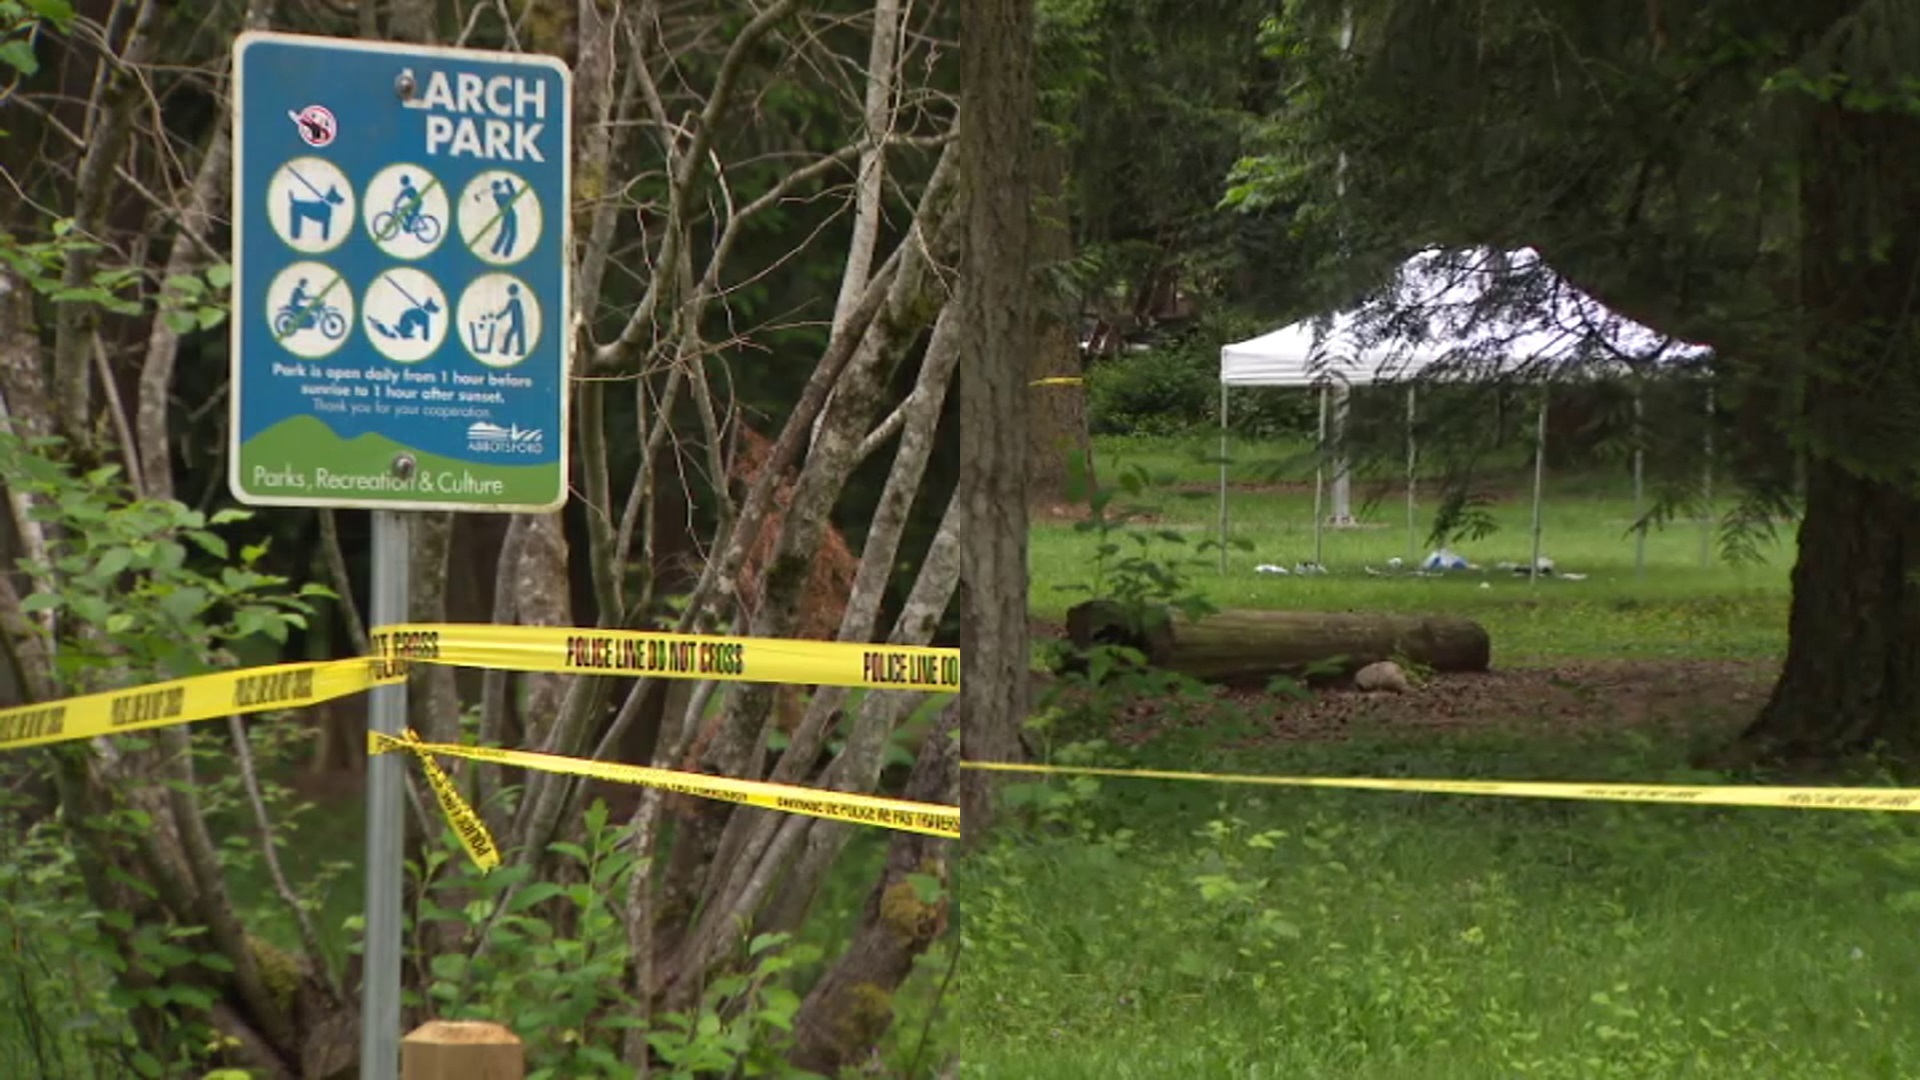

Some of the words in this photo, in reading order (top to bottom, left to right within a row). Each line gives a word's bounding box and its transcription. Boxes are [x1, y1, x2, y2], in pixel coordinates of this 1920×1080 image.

[402, 68, 546, 118] LARCH
[426, 116, 545, 162] PARK
[272, 362, 306, 377] Park
[310, 363, 323, 377] is
[325, 368, 361, 382] open
[365, 366, 399, 385] daily
[403, 367, 436, 384] from
[442, 370, 448, 384] 1
[453, 370, 485, 385] hour
[488, 371, 533, 388] before
[301, 382, 350, 396] sunrise
[354, 385, 369, 397] to
[374, 385, 380, 397] 1
[386, 385, 418, 399] hour
[421, 387, 454, 401] after
[458, 390, 506, 404] sunset.
[312, 398, 346, 411] Thank
[351, 404, 371, 416] you
[376, 401, 389, 414] for
[393, 404, 419, 418] your
[252, 463, 313, 492] Parks,
[316, 467, 416, 492] Recreation
[420, 471, 434, 493] &
[437, 469, 504, 496] Culture
[566, 636, 613, 668] POLICE
[616, 639, 646, 670] LINE
[648, 640, 666, 671] DO
[669, 641, 697, 673] NOT
[699, 642, 744, 675] CROSS
[863, 651, 907, 683] POLICE
[909, 654, 937, 684] LINE
[941, 656, 959, 686] DO
